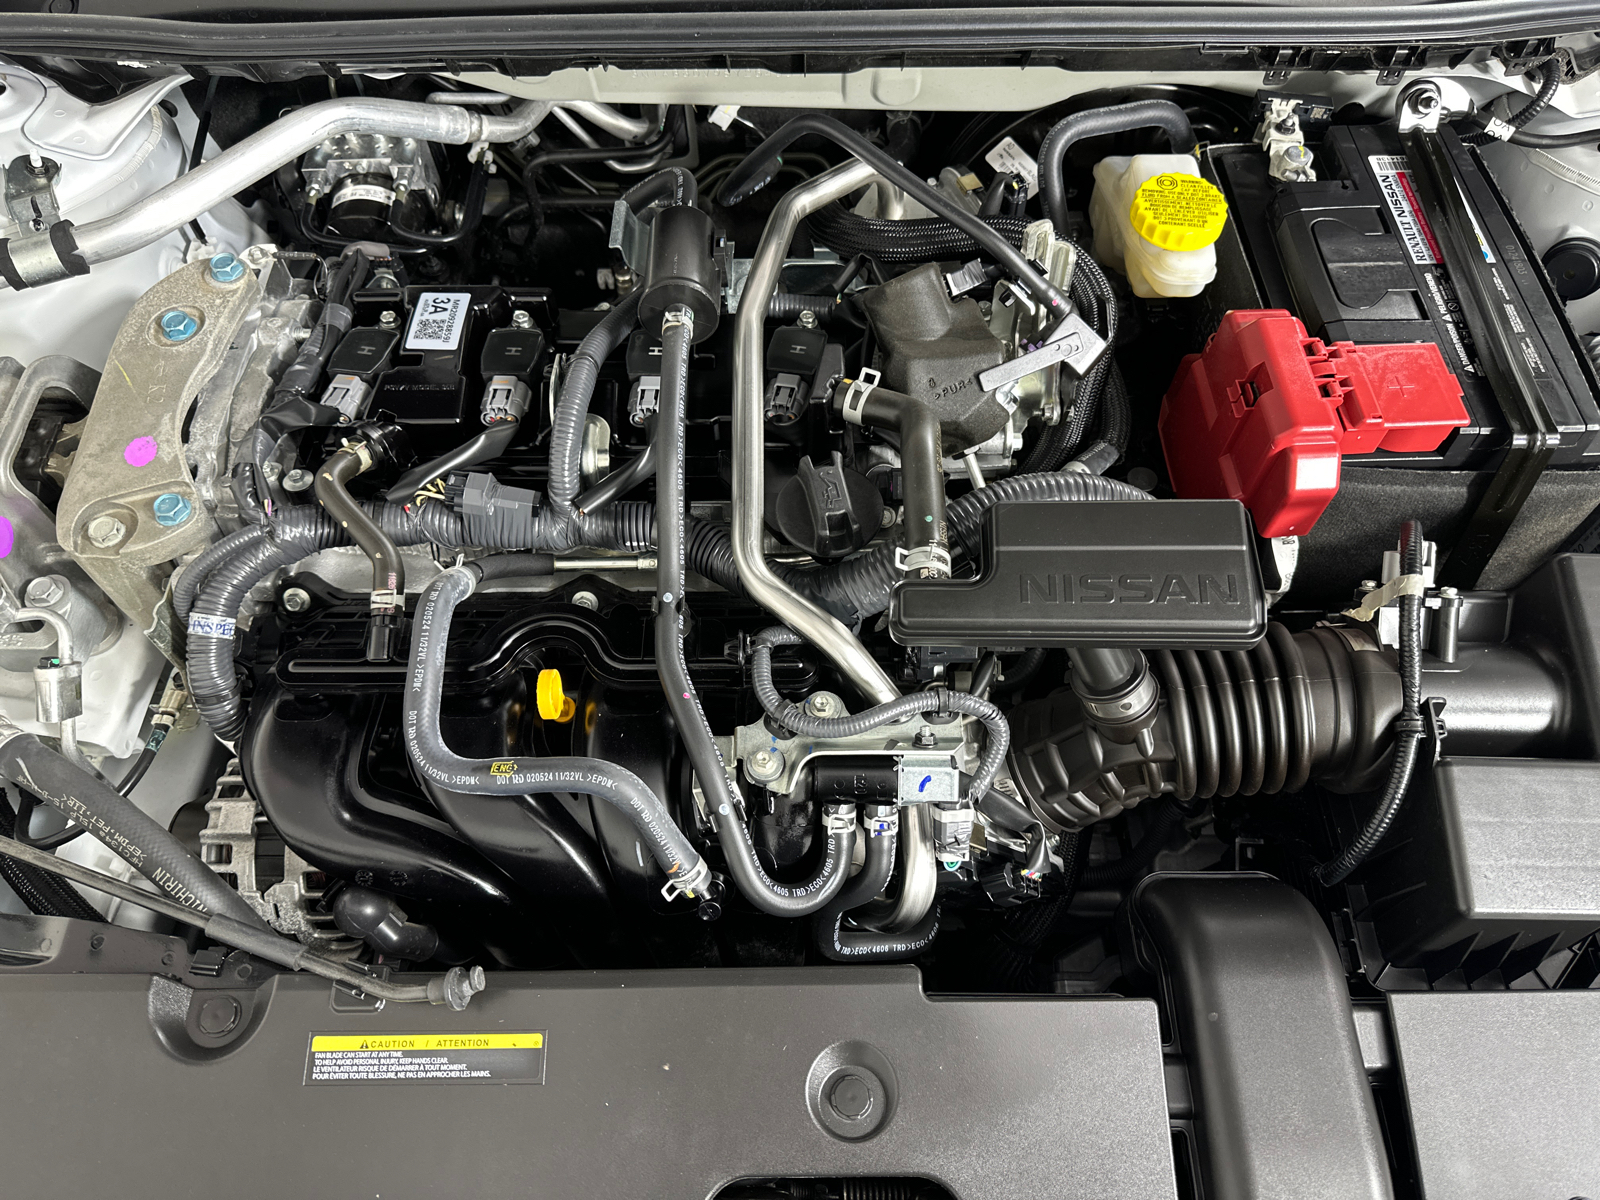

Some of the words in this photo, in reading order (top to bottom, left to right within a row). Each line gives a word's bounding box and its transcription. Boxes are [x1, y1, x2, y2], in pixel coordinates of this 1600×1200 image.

[1380, 174, 1407, 218] NISSAN
[1400, 220, 1427, 261] RENAULT
[429, 298, 451, 314] 3A
[1020, 574, 1240, 604] NISSAN
[422, 602, 434, 630] 020524
[409, 711, 417, 724] DOT
[410, 740, 425, 766] 020524
[527, 773, 553, 783] 020524
[630, 797, 643, 811] DOT
[648, 821, 665, 846] 020524
